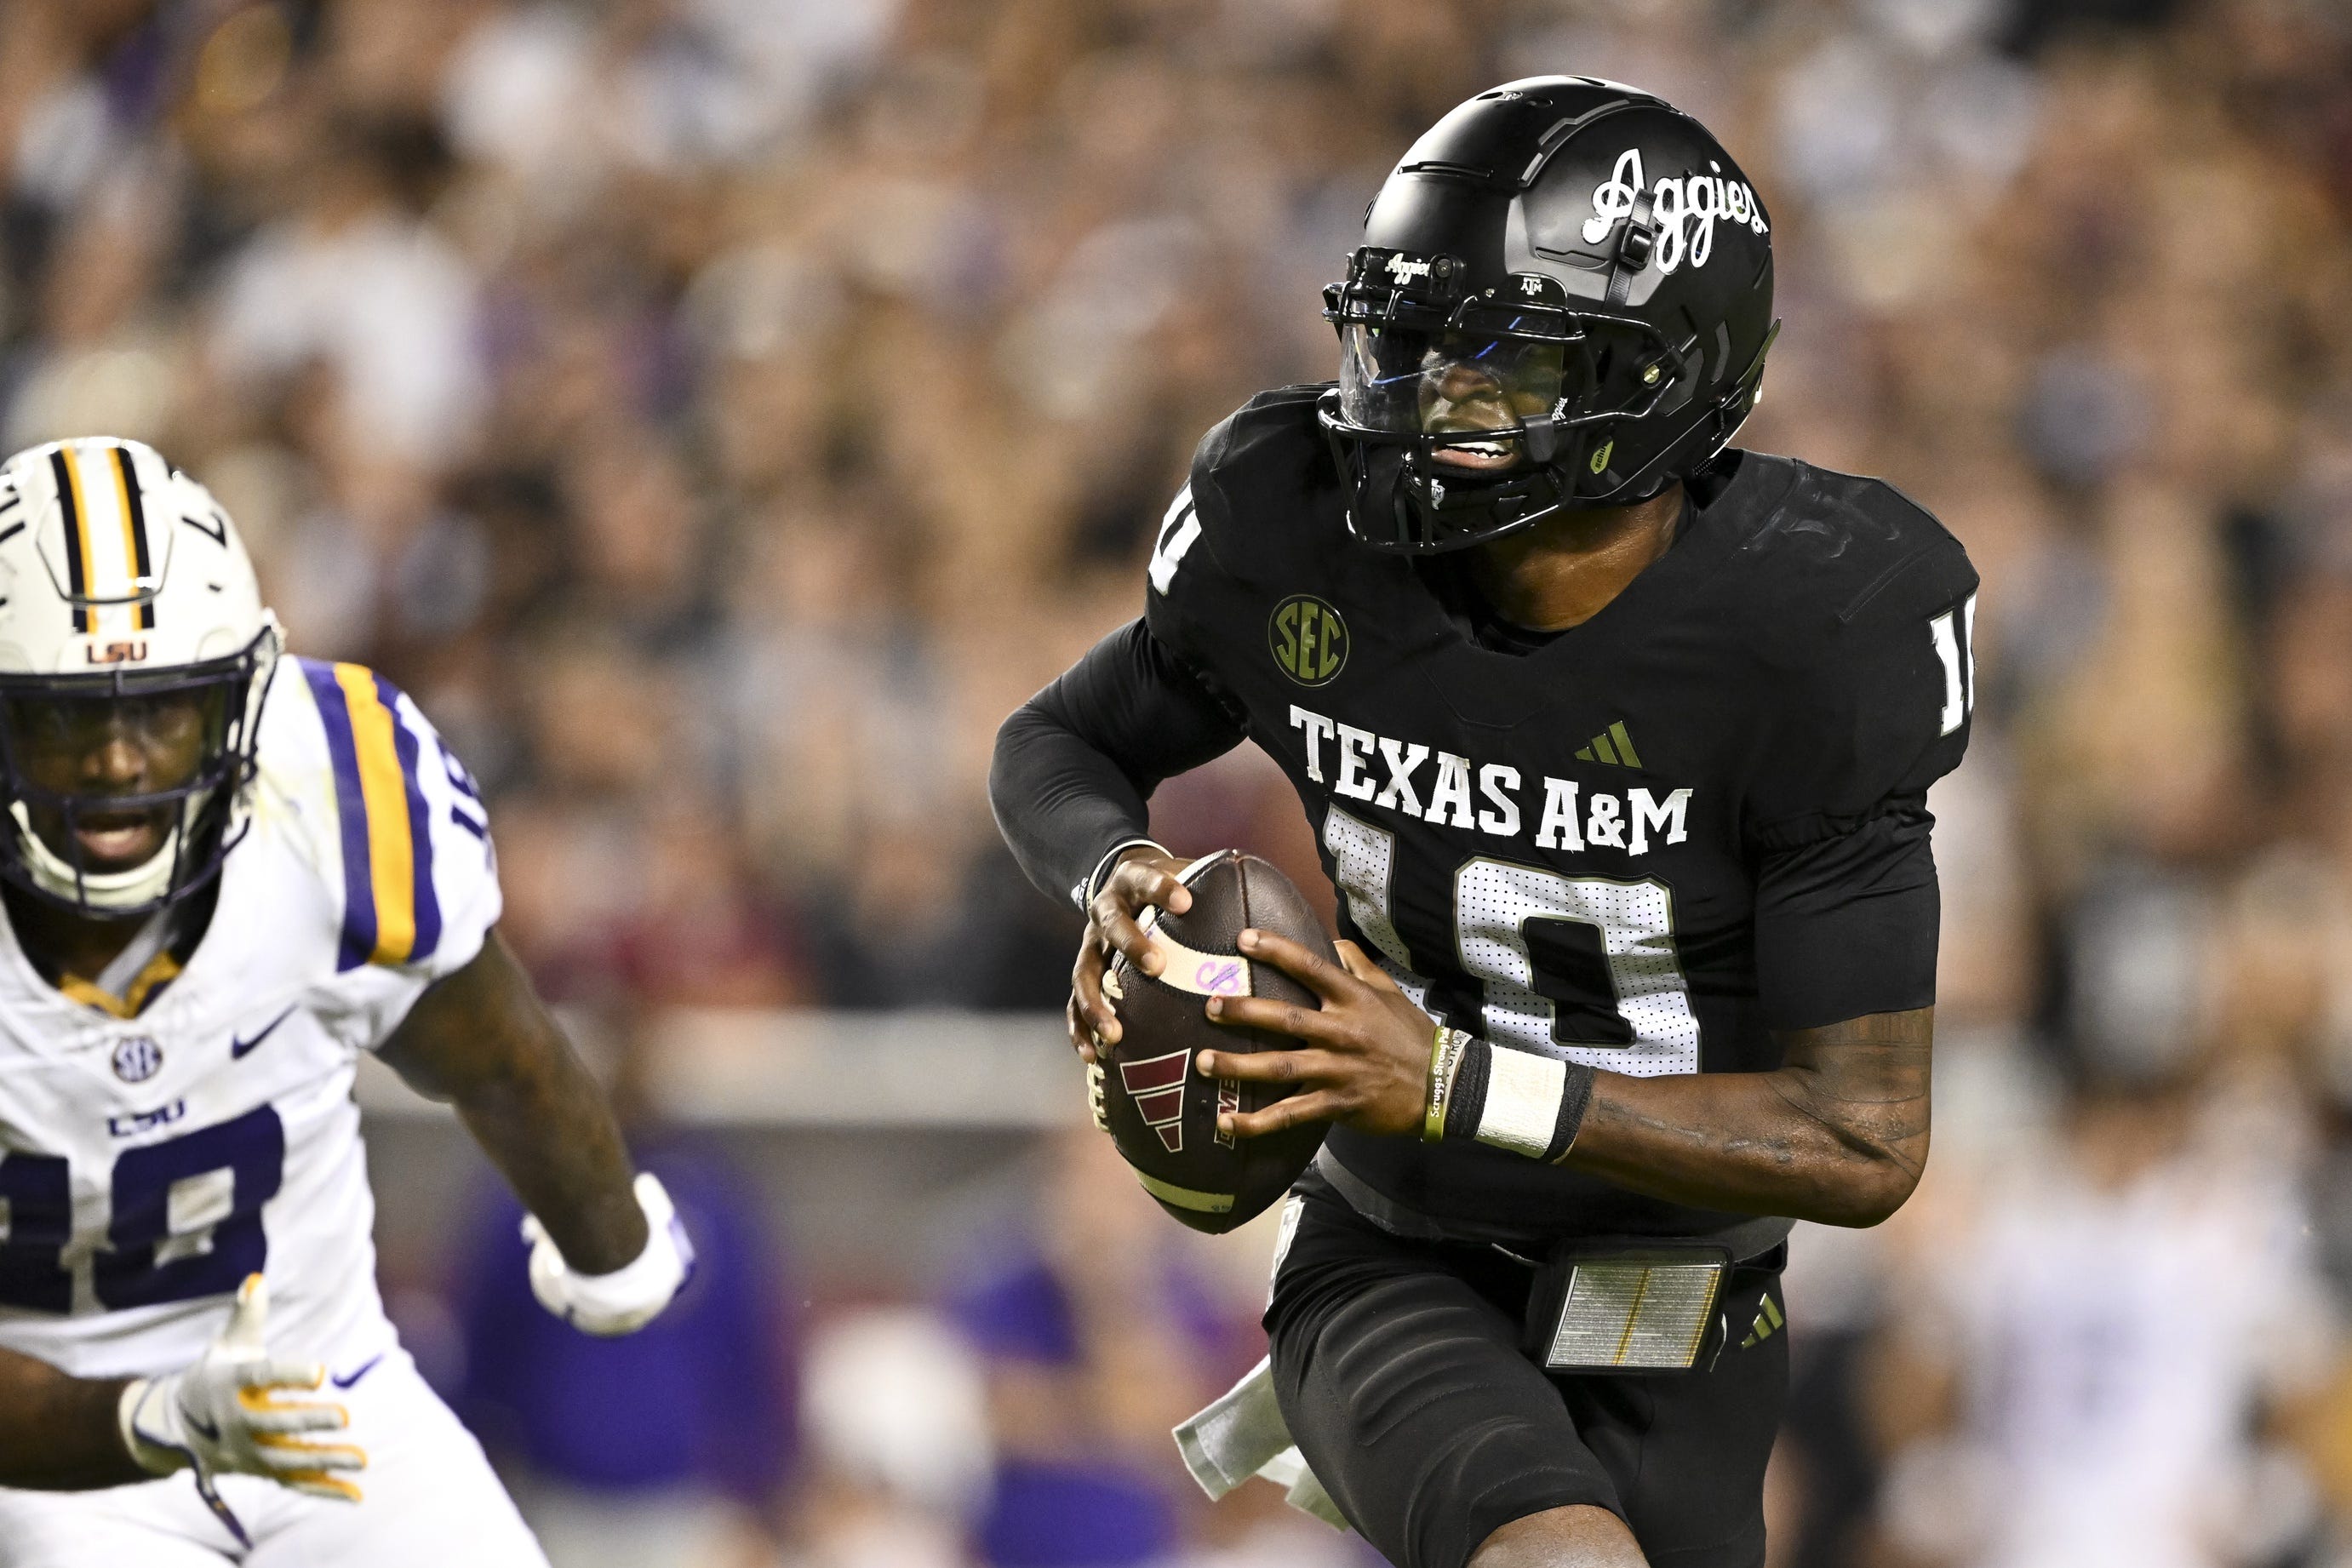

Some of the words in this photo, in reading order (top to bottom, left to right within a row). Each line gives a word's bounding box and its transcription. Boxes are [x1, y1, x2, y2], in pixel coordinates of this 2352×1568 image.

[1582, 148, 1770, 275] Aggies
[87, 640, 147, 664] LSU
[1275, 600, 1342, 680] SEC
[1290, 704, 1522, 837] TEXAS
[1535, 775, 1694, 856] A&M
[1323, 801, 1702, 1078] 10
[1430, 1077, 1445, 1118] Scruggs
[1433, 1044, 1451, 1077] Strong
